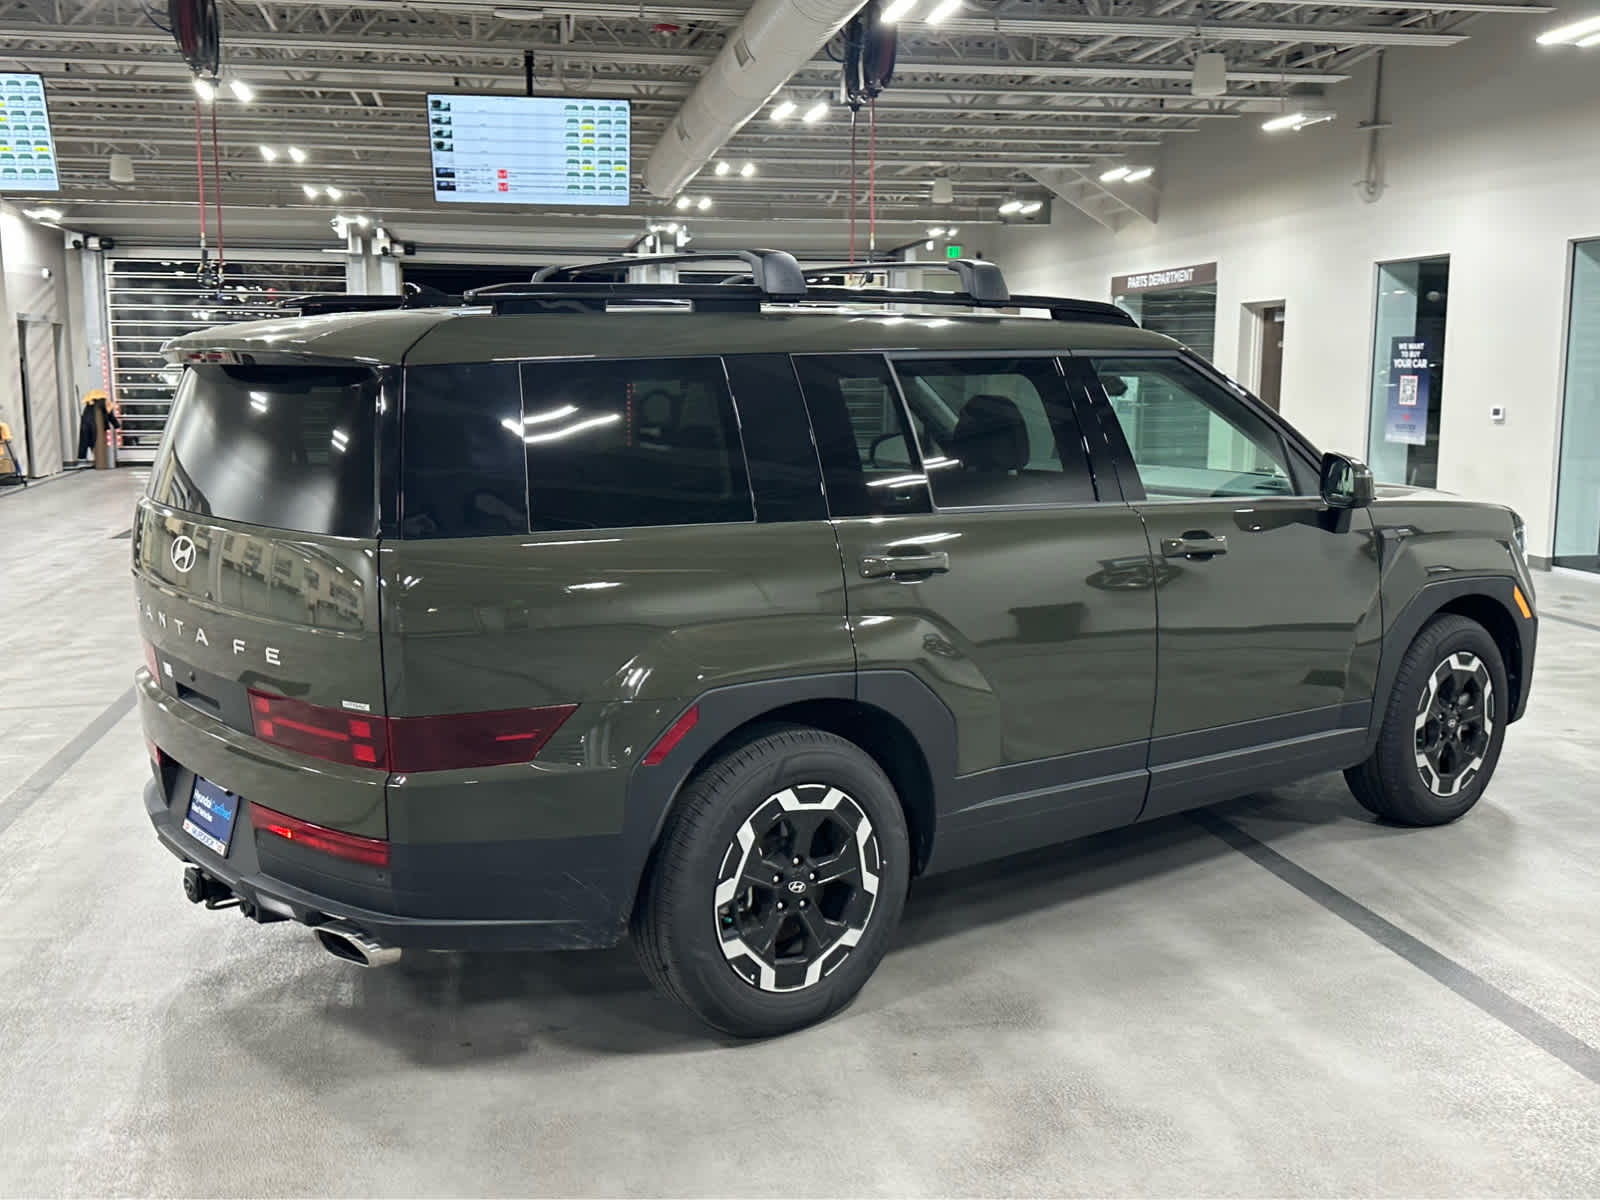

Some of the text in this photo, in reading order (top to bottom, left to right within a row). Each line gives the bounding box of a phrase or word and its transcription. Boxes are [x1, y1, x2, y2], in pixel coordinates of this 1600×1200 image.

[1128, 268, 1194, 288] PARTS DEPARTMENT
[1399, 342, 1424, 350] WE WANT
[1394, 359, 1427, 368] YOUR CAR
[233, 639, 280, 666] FE
